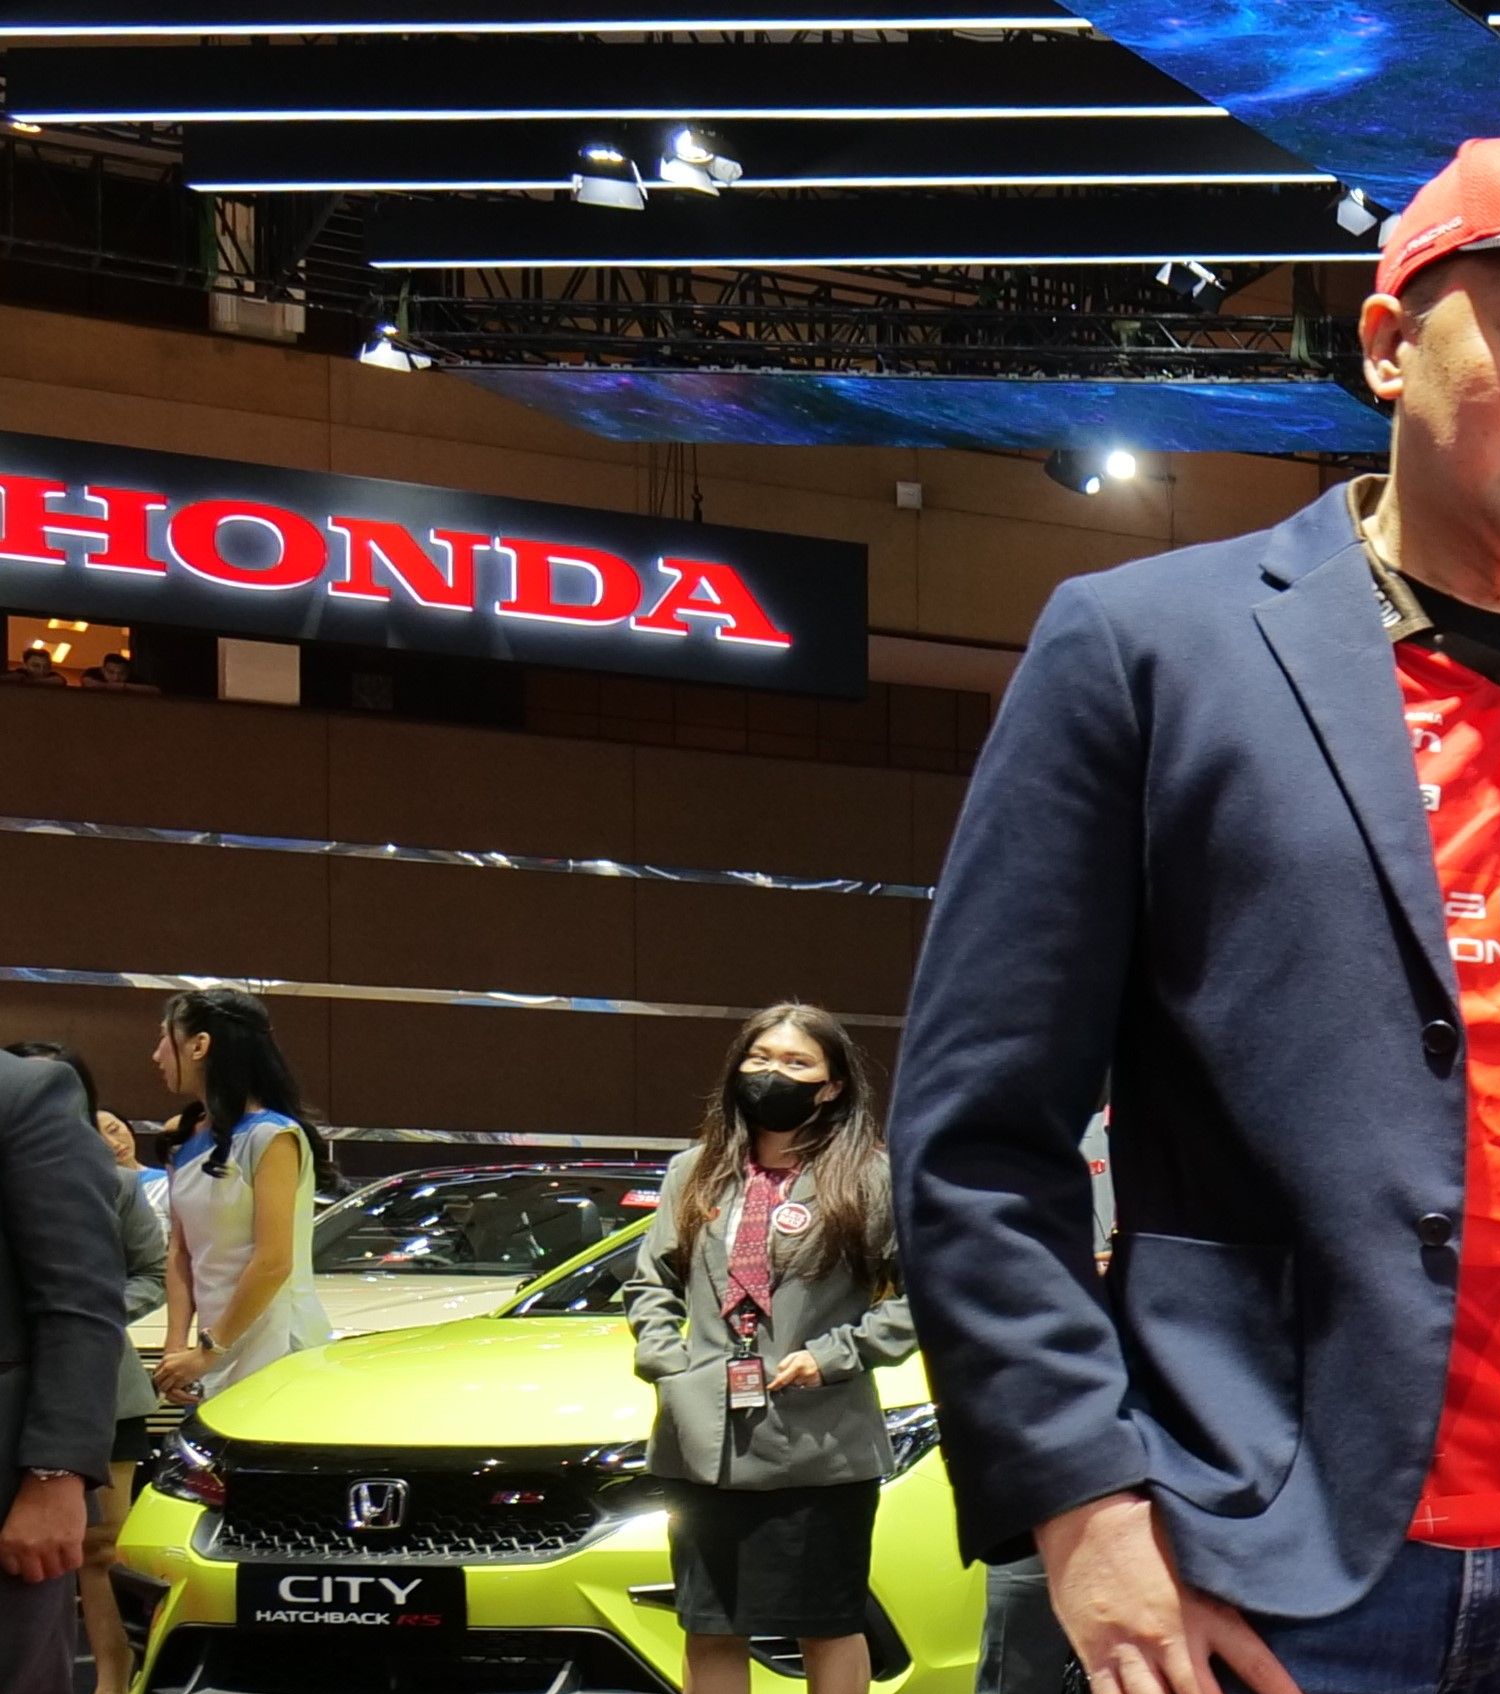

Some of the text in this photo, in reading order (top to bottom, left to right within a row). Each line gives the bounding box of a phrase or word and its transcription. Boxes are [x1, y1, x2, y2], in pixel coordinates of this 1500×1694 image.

[0, 471, 793, 648] HONDA
[277, 1575, 423, 1605] CITY
[255, 1609, 444, 1627] HATCHBACK RS
